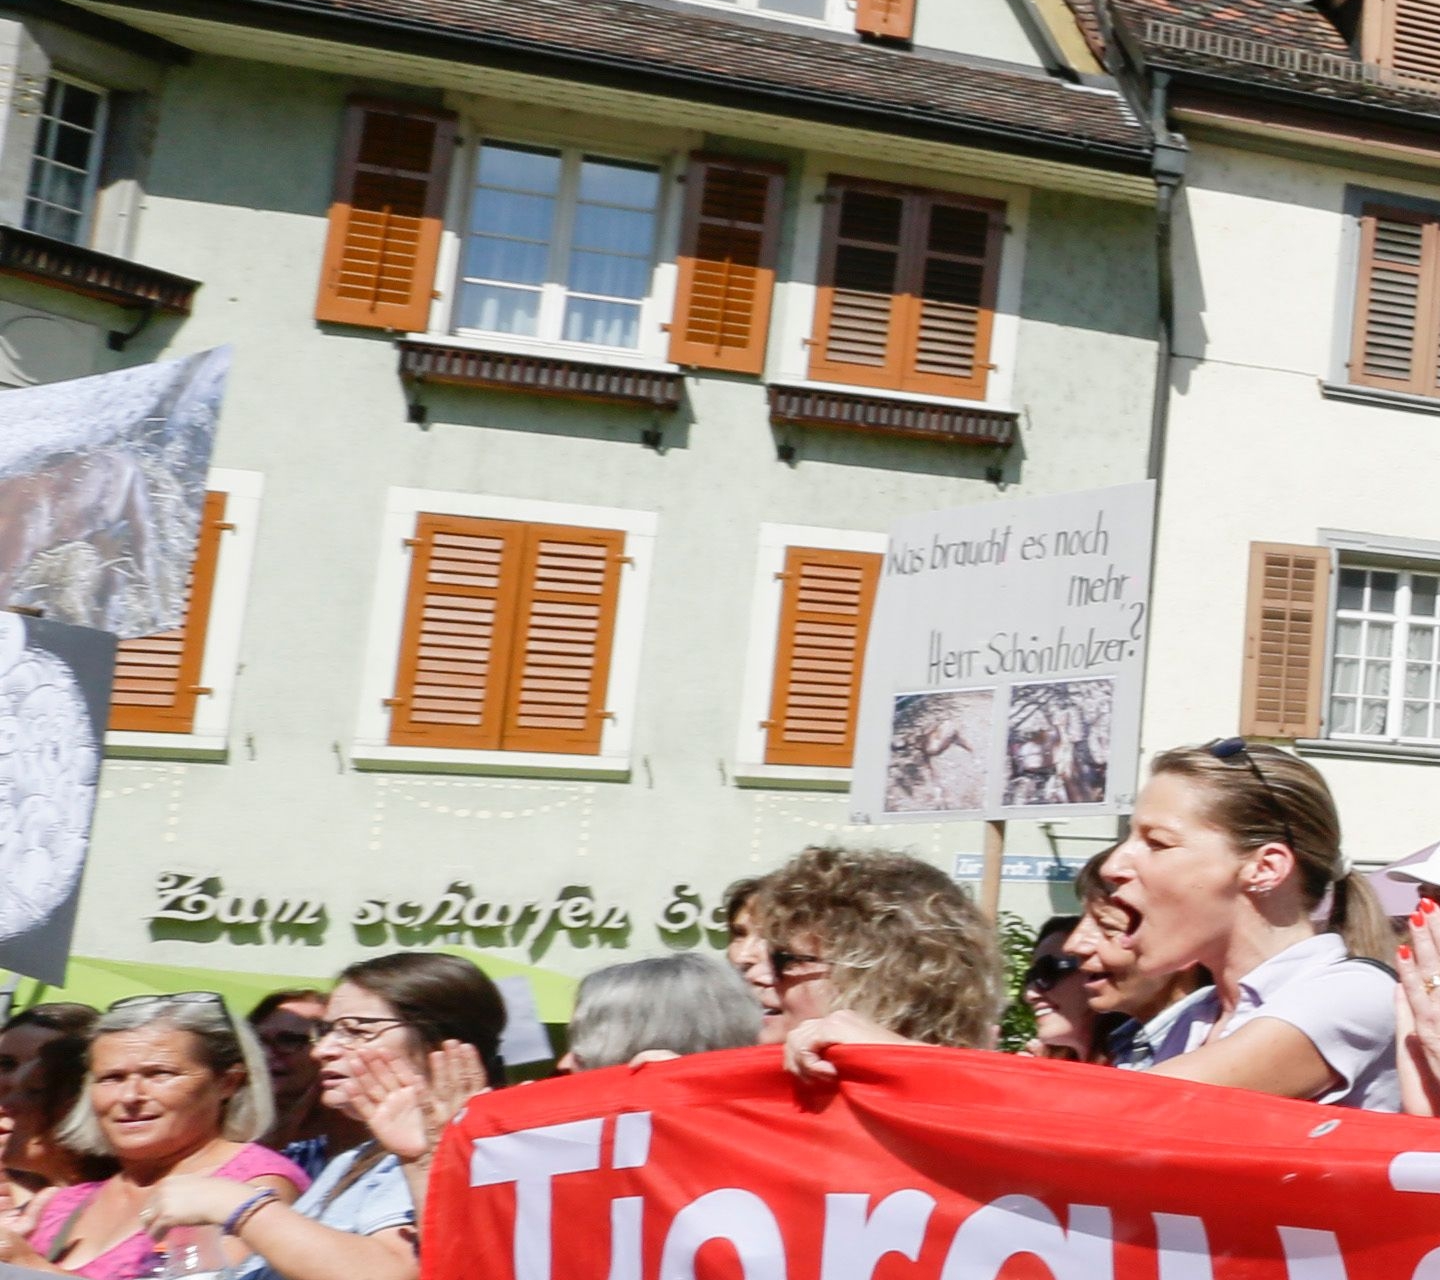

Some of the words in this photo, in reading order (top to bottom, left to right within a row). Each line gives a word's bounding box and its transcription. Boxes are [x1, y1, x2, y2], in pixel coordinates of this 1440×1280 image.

[930, 525, 1012, 570] braucht
[1020, 534, 1047, 562] es
[1055, 510, 1108, 557] noch
[928, 629, 981, 684] Herr
[146, 869, 324, 928] Zum
[351, 880, 629, 942] scharfen
